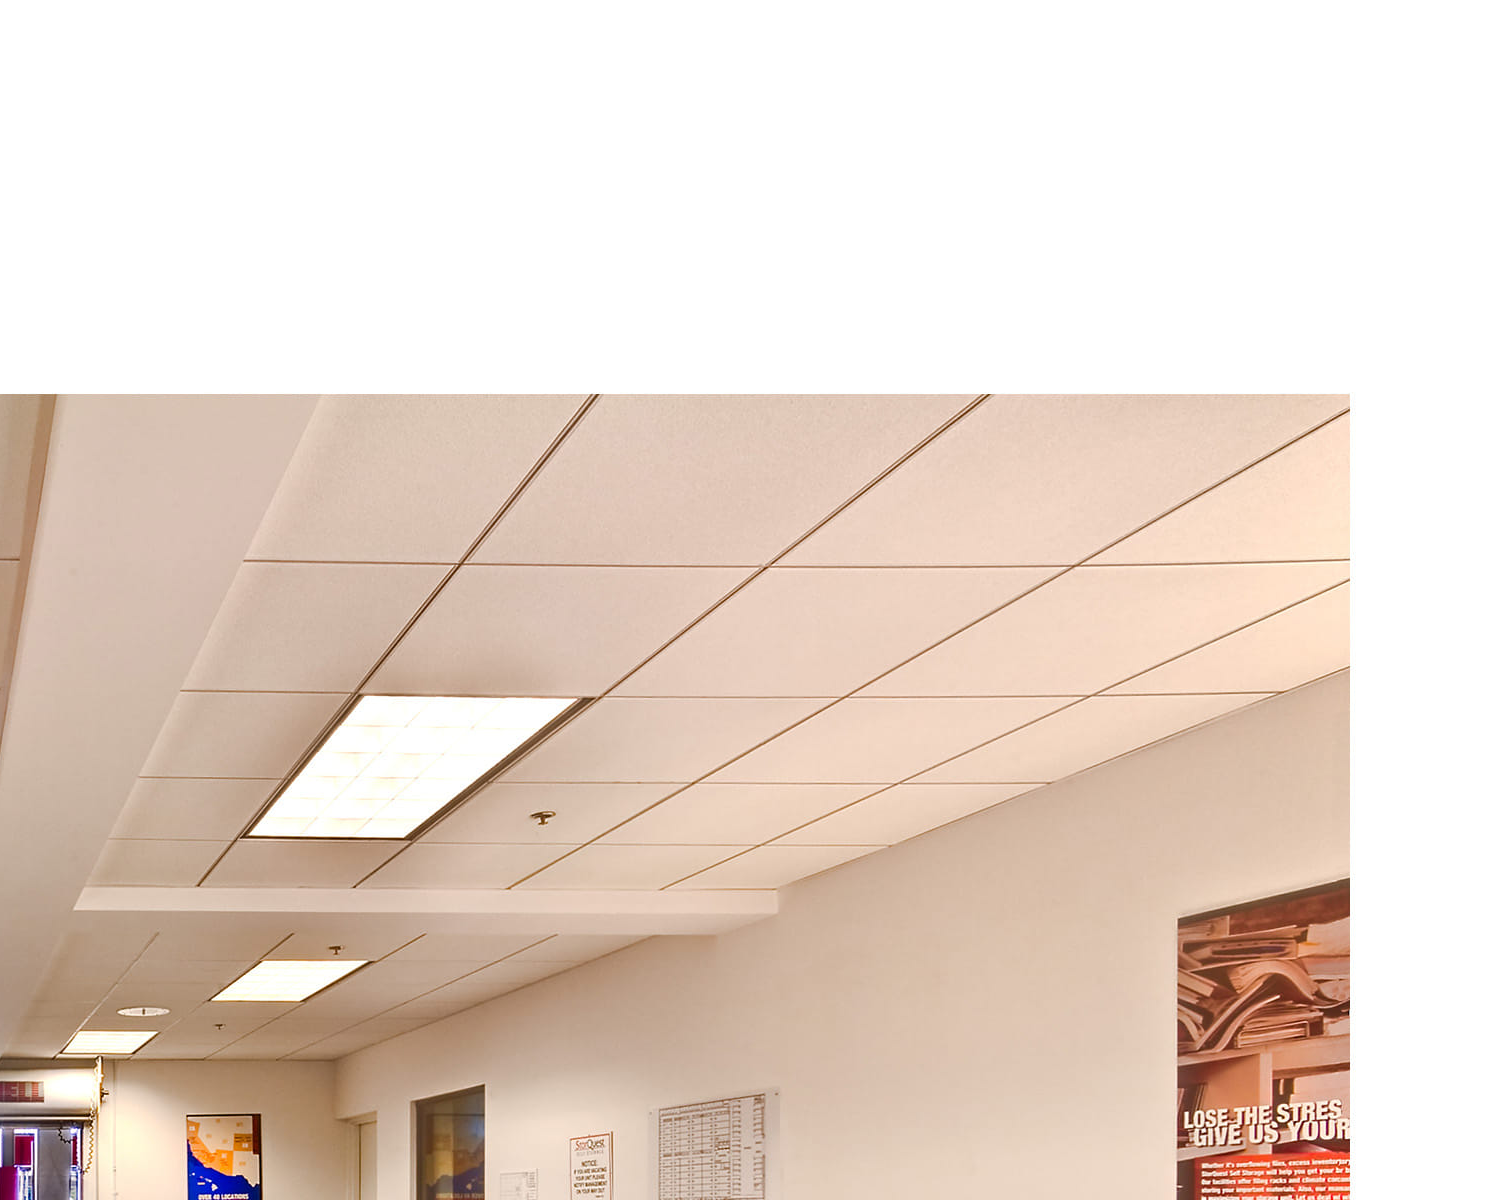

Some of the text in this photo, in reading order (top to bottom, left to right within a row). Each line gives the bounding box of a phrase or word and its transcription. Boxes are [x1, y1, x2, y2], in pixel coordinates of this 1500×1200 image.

[1183, 1099, 1342, 1129] LOSE THE STRES
[1194, 1118, 1350, 1147] GIVE US YOUR
[1306, 1167, 1318, 1175] get
